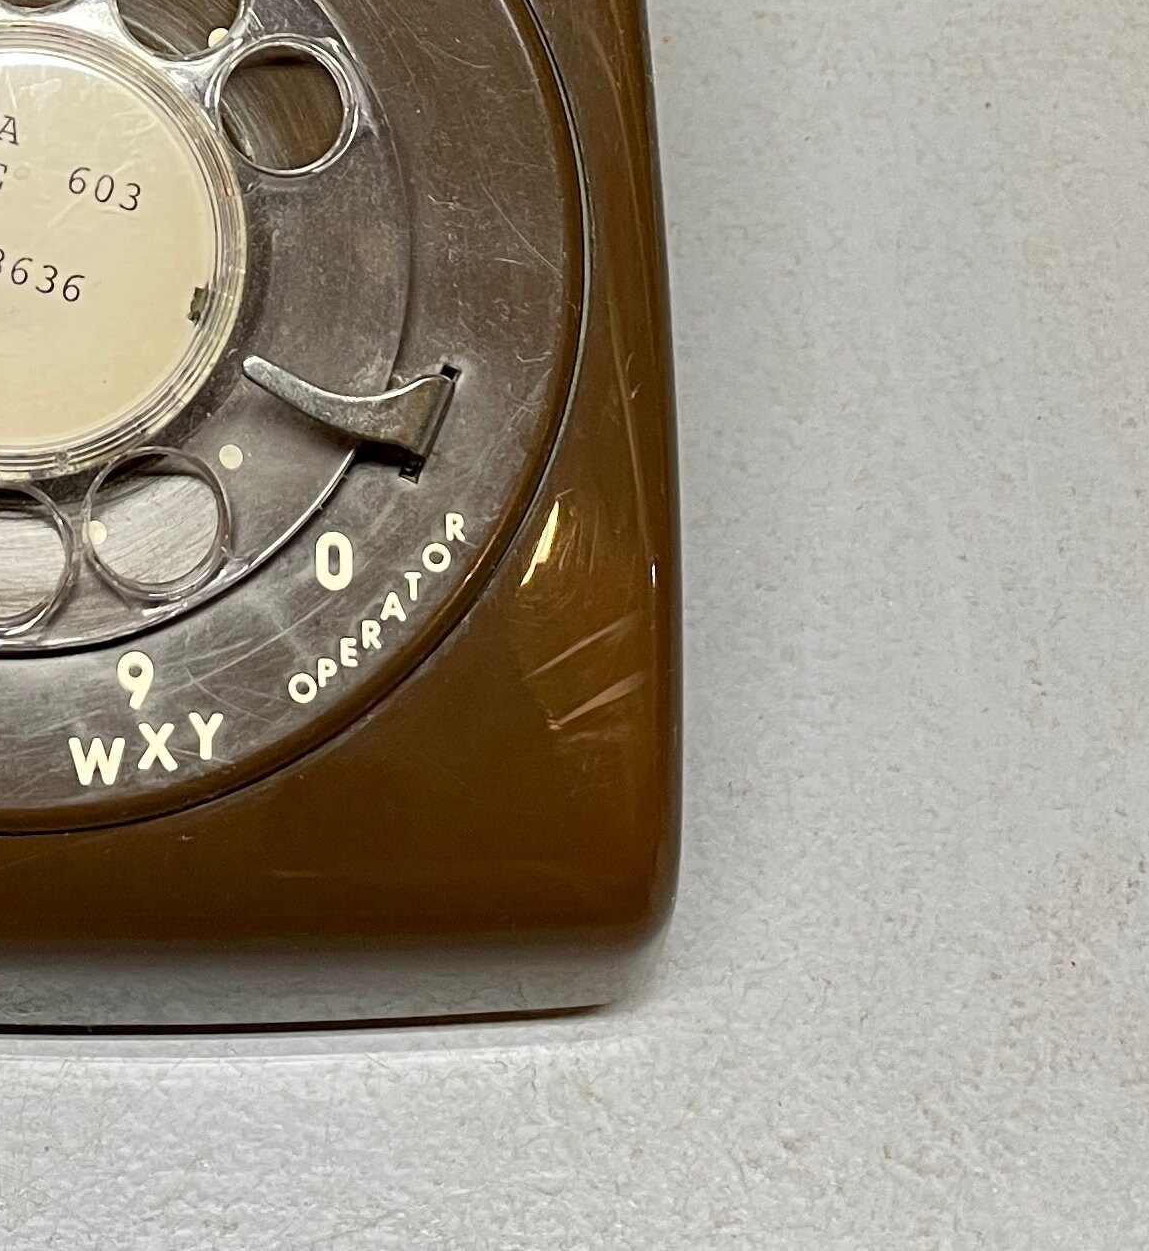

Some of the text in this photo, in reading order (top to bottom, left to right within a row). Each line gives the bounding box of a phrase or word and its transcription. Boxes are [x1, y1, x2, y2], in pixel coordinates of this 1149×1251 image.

[68, 166, 142, 211] 603
[288, 512, 465, 704] OPERATOR
[116, 650, 155, 710] 9
